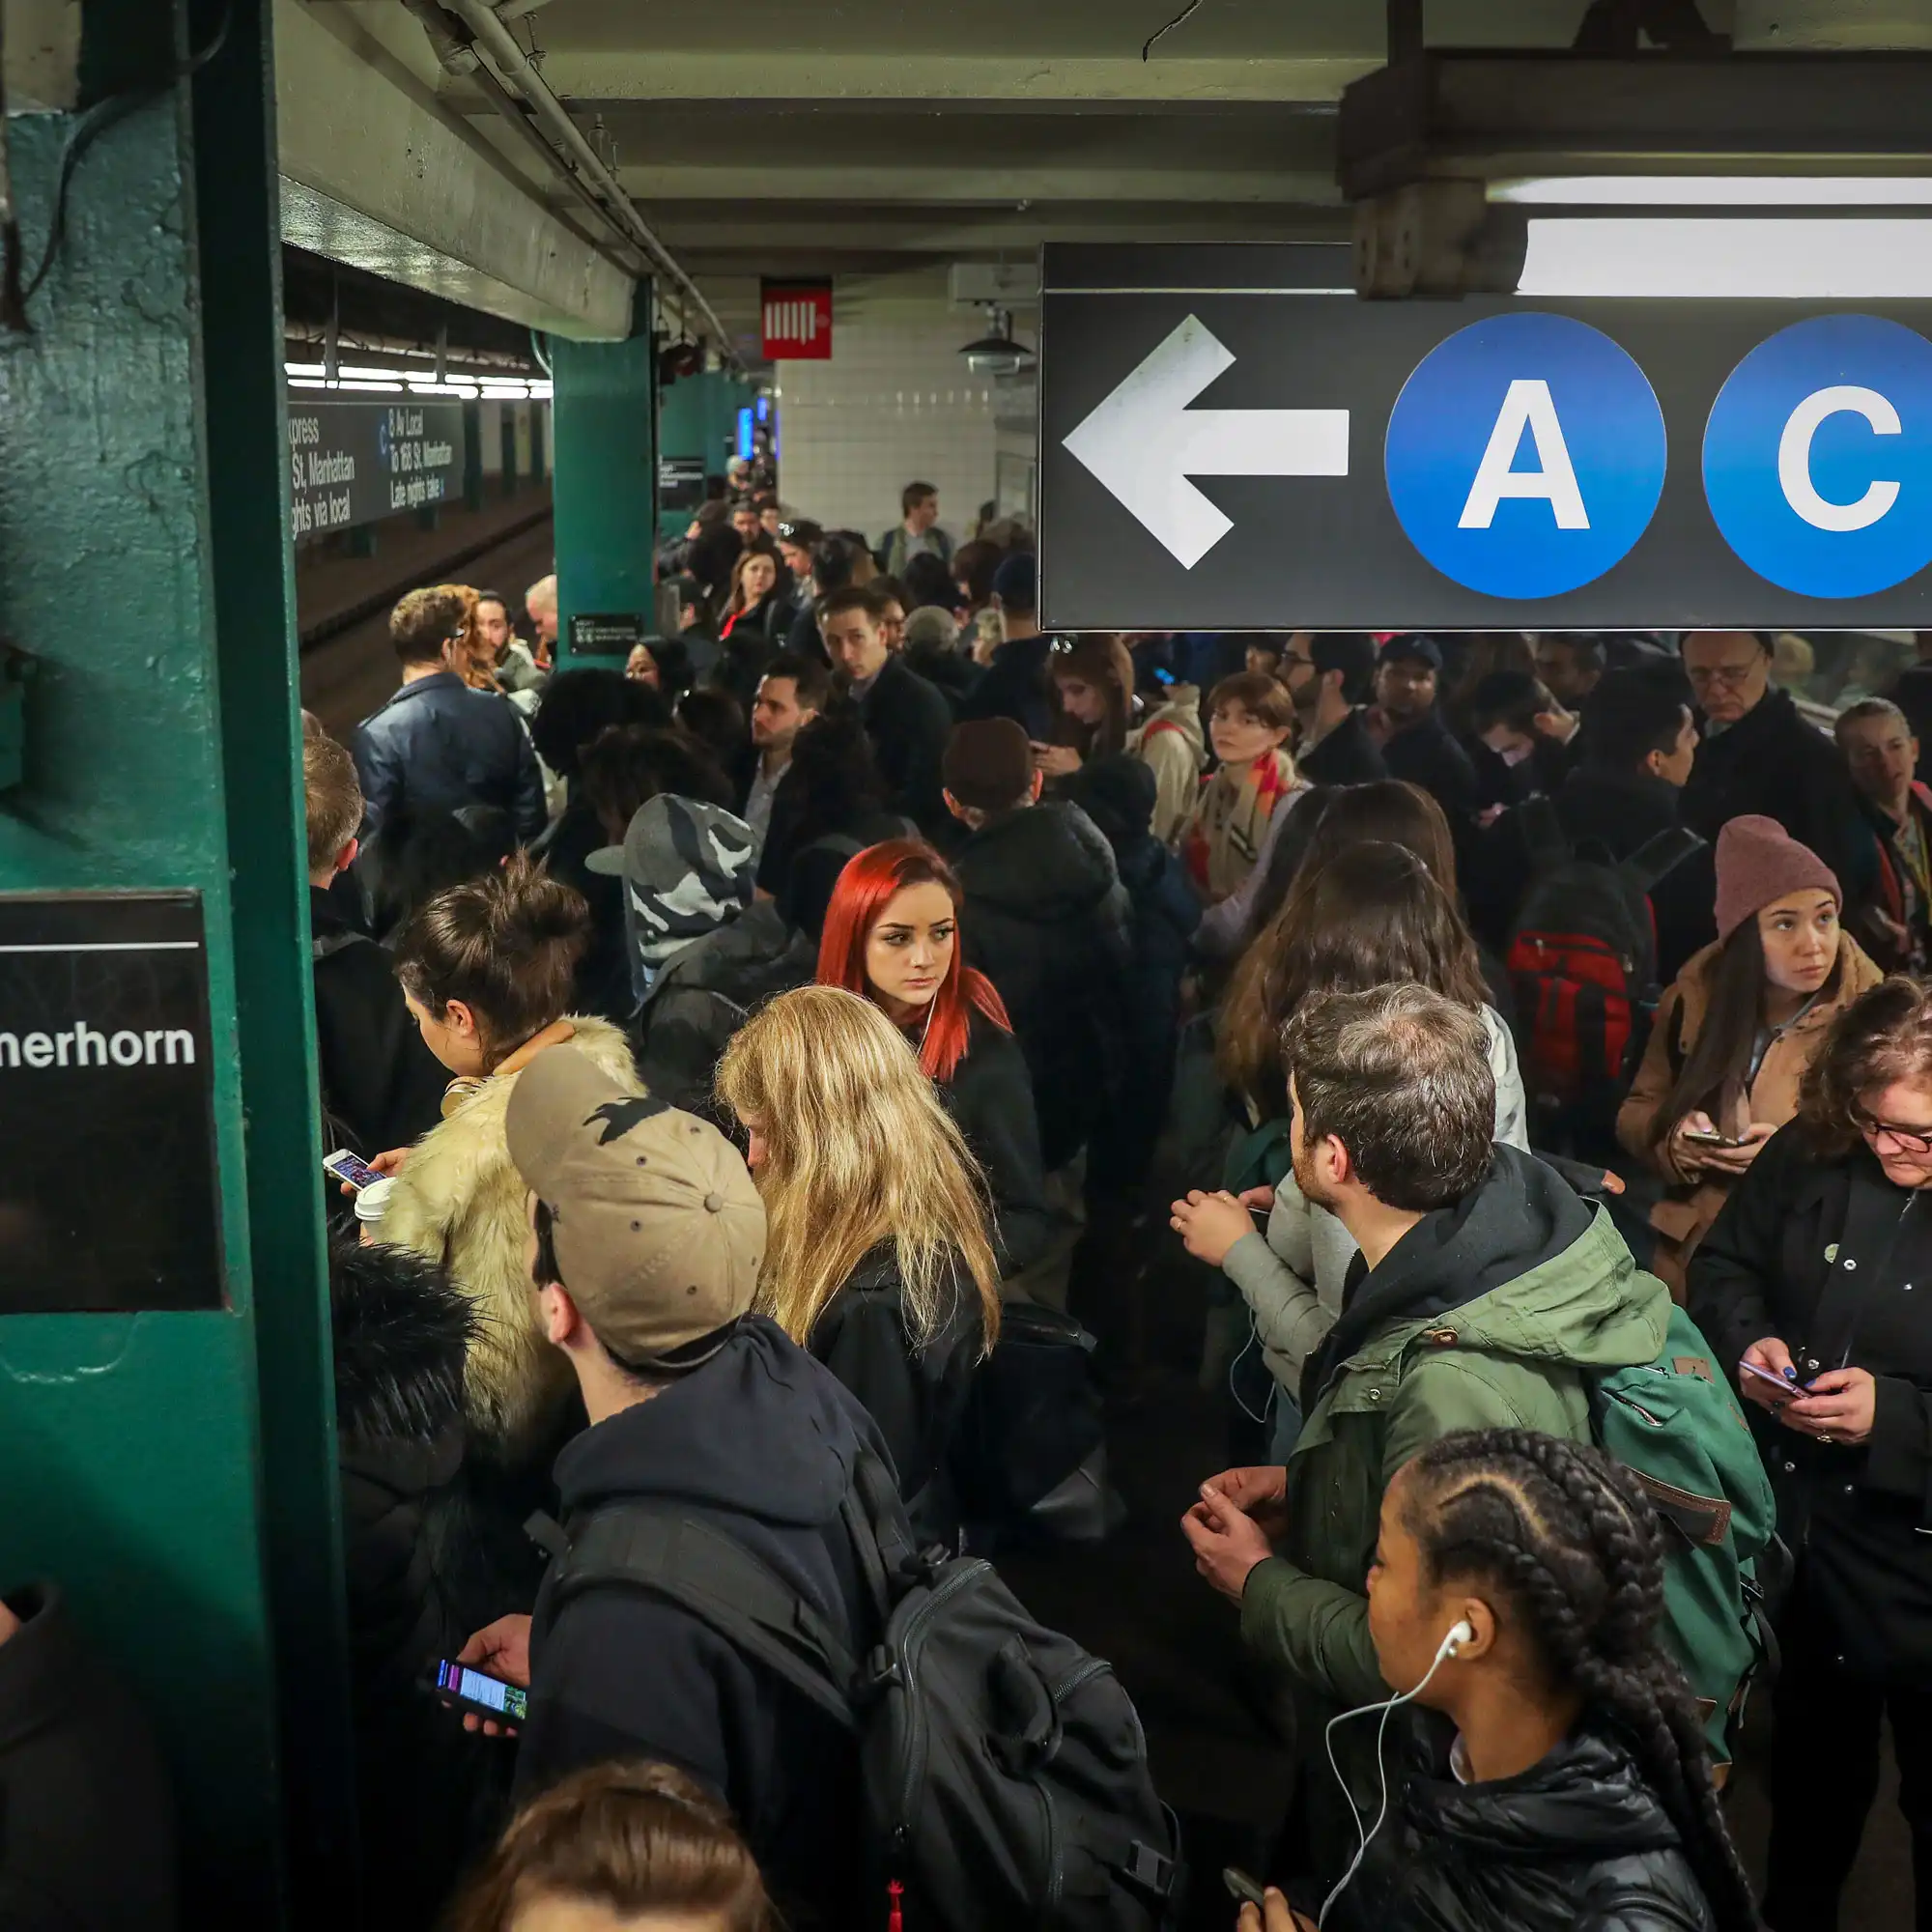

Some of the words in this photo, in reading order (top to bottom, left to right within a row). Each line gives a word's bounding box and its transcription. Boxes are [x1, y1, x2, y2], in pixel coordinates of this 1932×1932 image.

[309, 450, 355, 487] Manhattan
[1457, 379, 1590, 529] A
[1777, 384, 1902, 531] C
[314, 492, 327, 527] via
[329, 488, 351, 524] local
